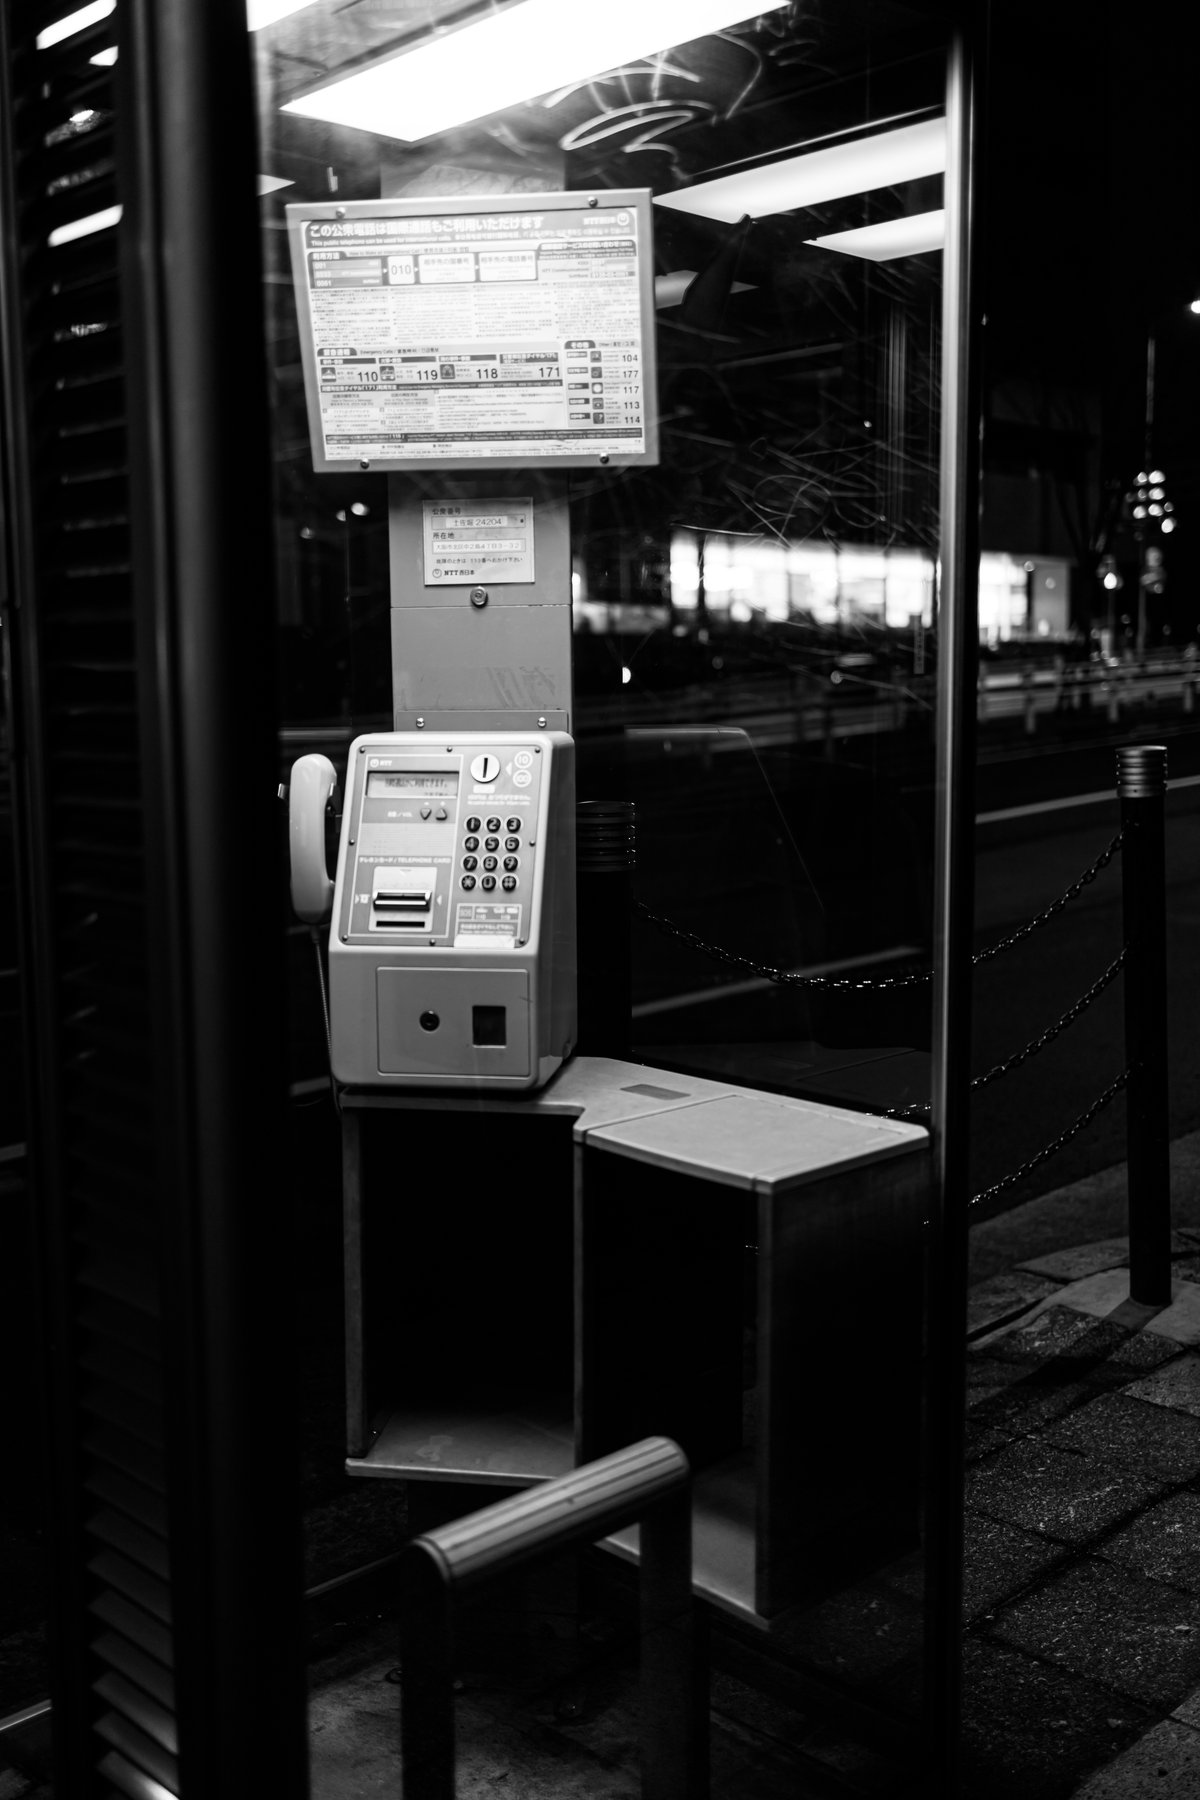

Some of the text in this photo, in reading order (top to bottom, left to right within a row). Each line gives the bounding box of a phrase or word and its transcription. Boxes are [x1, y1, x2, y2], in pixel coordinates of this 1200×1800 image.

[391, 265, 411, 275] 010
[358, 371, 378, 382] 110
[417, 370, 438, 380] 119
[476, 368, 498, 379] 118
[539, 367, 560, 378] 171
[476, 518, 501, 526] 24204
[518, 756, 528, 765] 10
[471, 818, 517, 829] 1 2 3
[466, 838, 515, 849] 4 5 6
[466, 858, 514, 869] 7 8 9
[483, 878, 493, 888] 0
